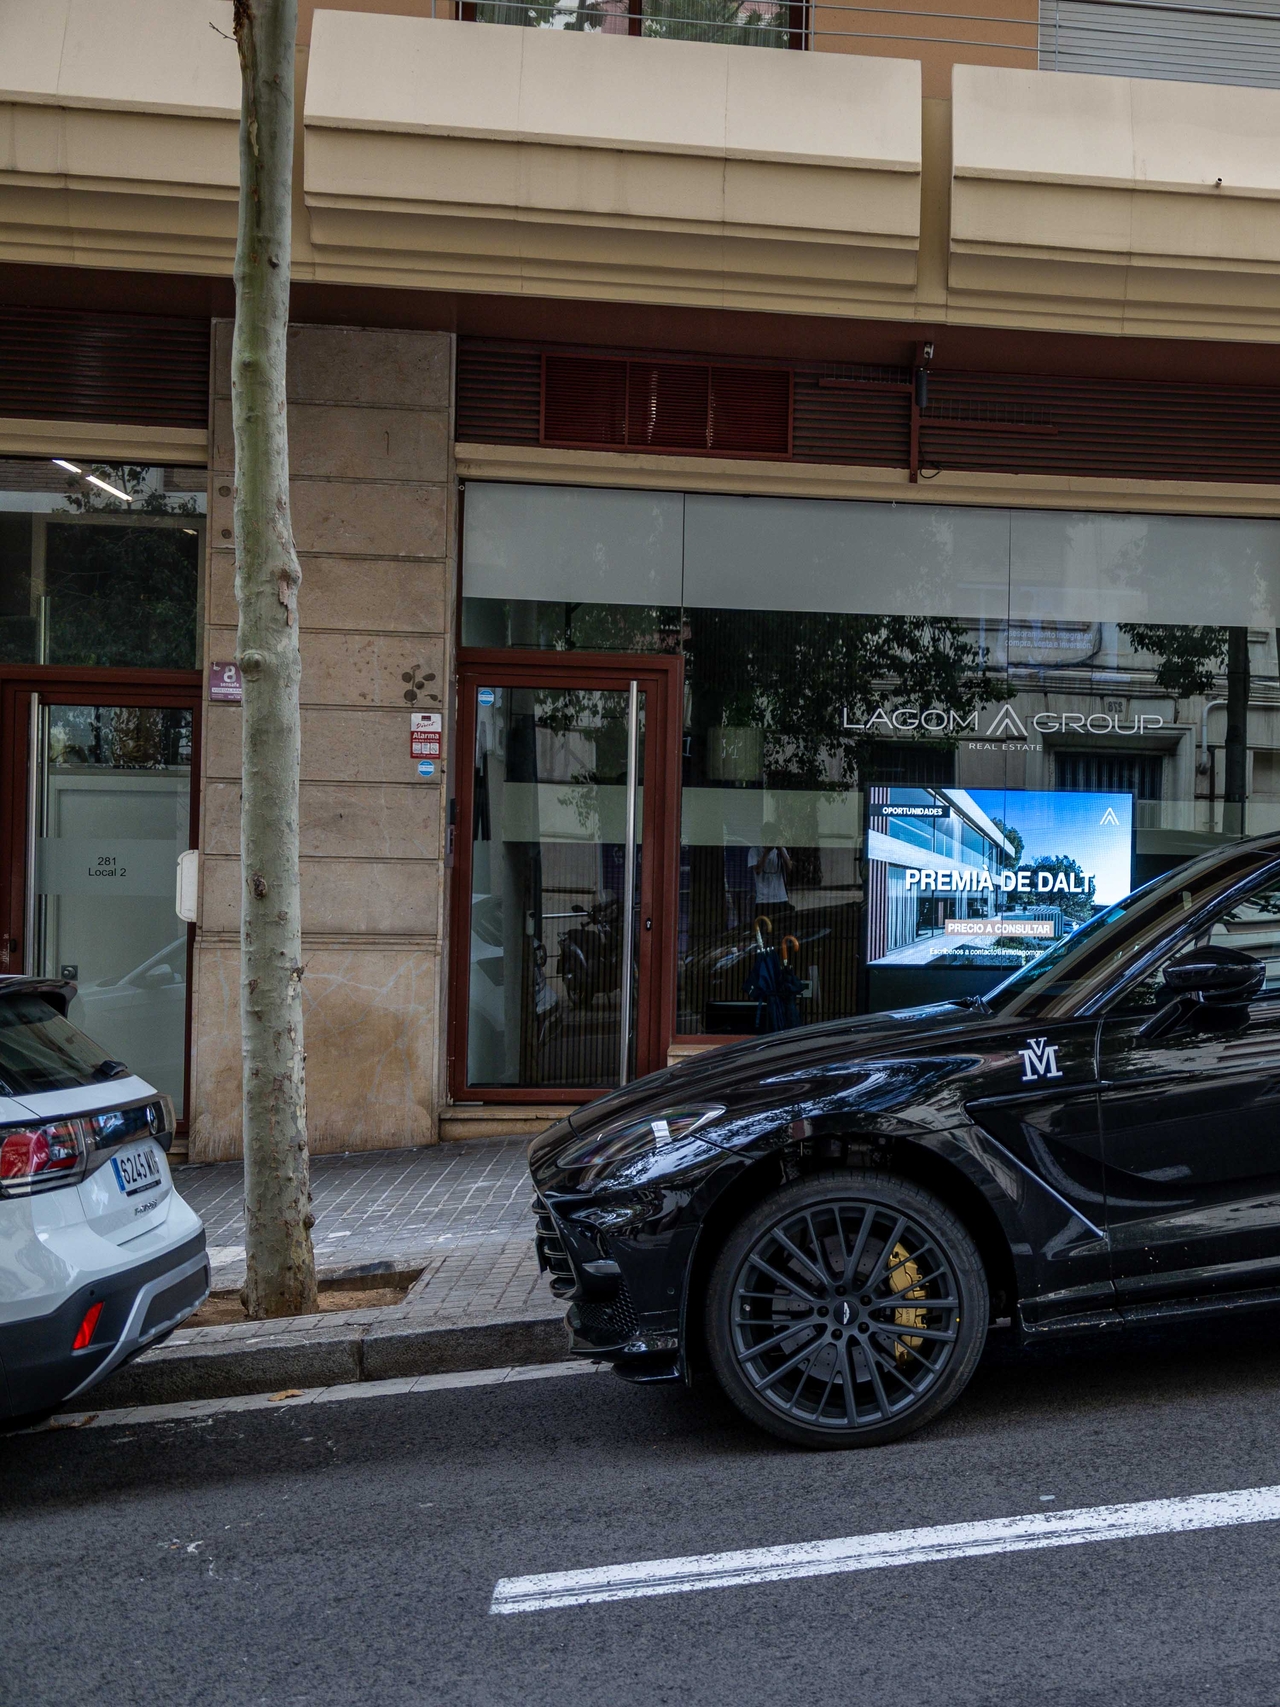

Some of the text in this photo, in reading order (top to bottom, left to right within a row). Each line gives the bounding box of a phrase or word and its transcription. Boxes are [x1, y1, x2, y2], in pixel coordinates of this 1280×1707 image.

[843, 707, 1164, 735] LAGOM GROUP
[412, 731, 439, 739] Alarma
[968, 742, 1043, 751] REAL ESTATE
[882, 806, 943, 816] OPORTUNIDADES
[97, 856, 116, 866] 281
[88, 867, 127, 877] Local 2
[905, 864, 1095, 893] PREMIÀ DE DALT
[948, 923, 1050, 935] PRECIO A CONSULTAR
[120, 1153, 148, 1184] 6245
